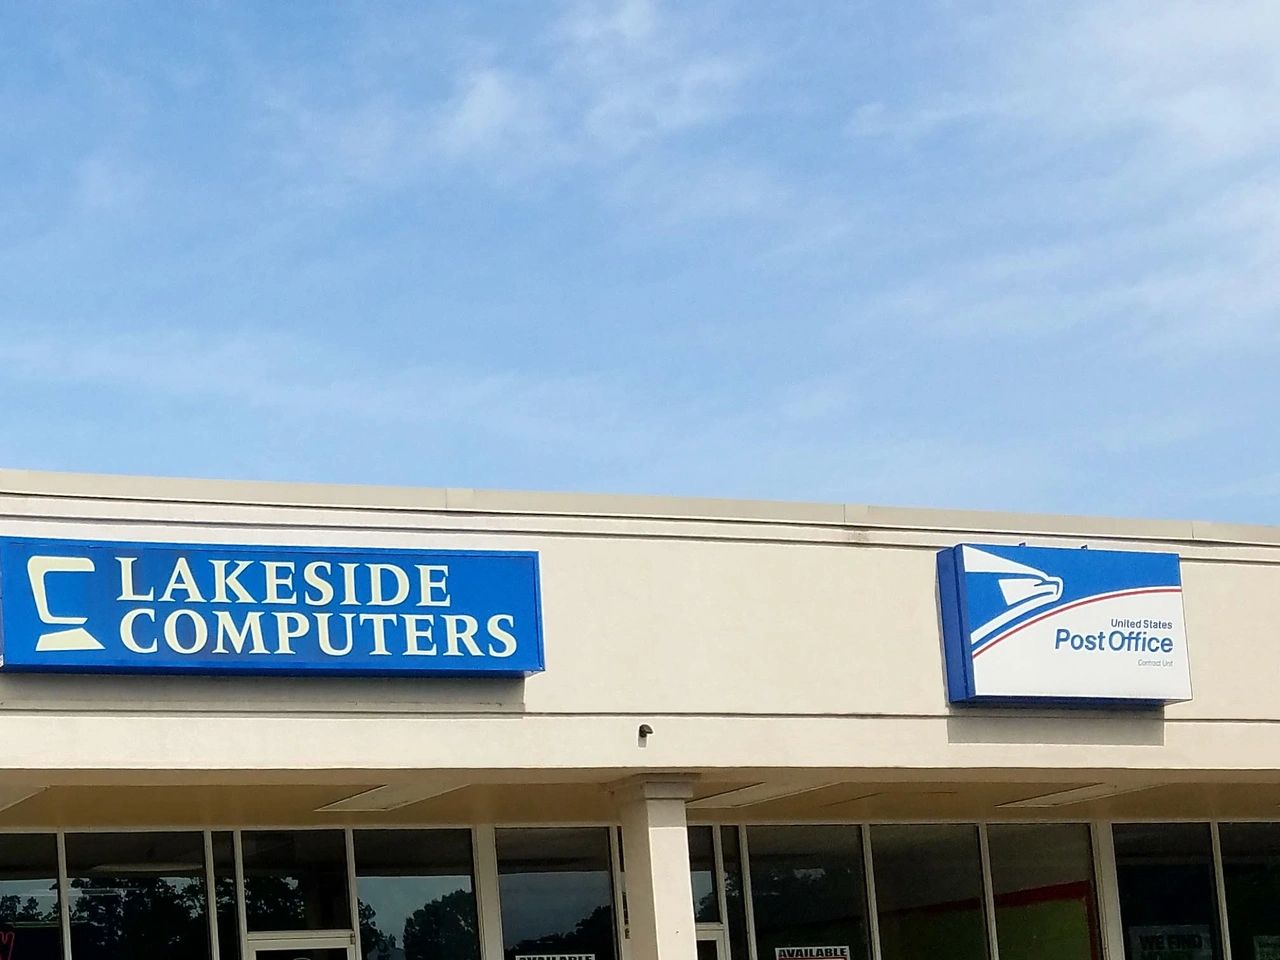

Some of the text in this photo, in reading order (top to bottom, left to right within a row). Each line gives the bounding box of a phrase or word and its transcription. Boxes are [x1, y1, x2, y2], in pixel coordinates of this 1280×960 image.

[115, 556, 452, 608] LAKESIDE
[119, 608, 519, 659] COMPUTERS
[1111, 618, 1173, 630] United States
[1055, 628, 1174, 653] Post Office
[779, 948, 847, 957] AVAILABLE
